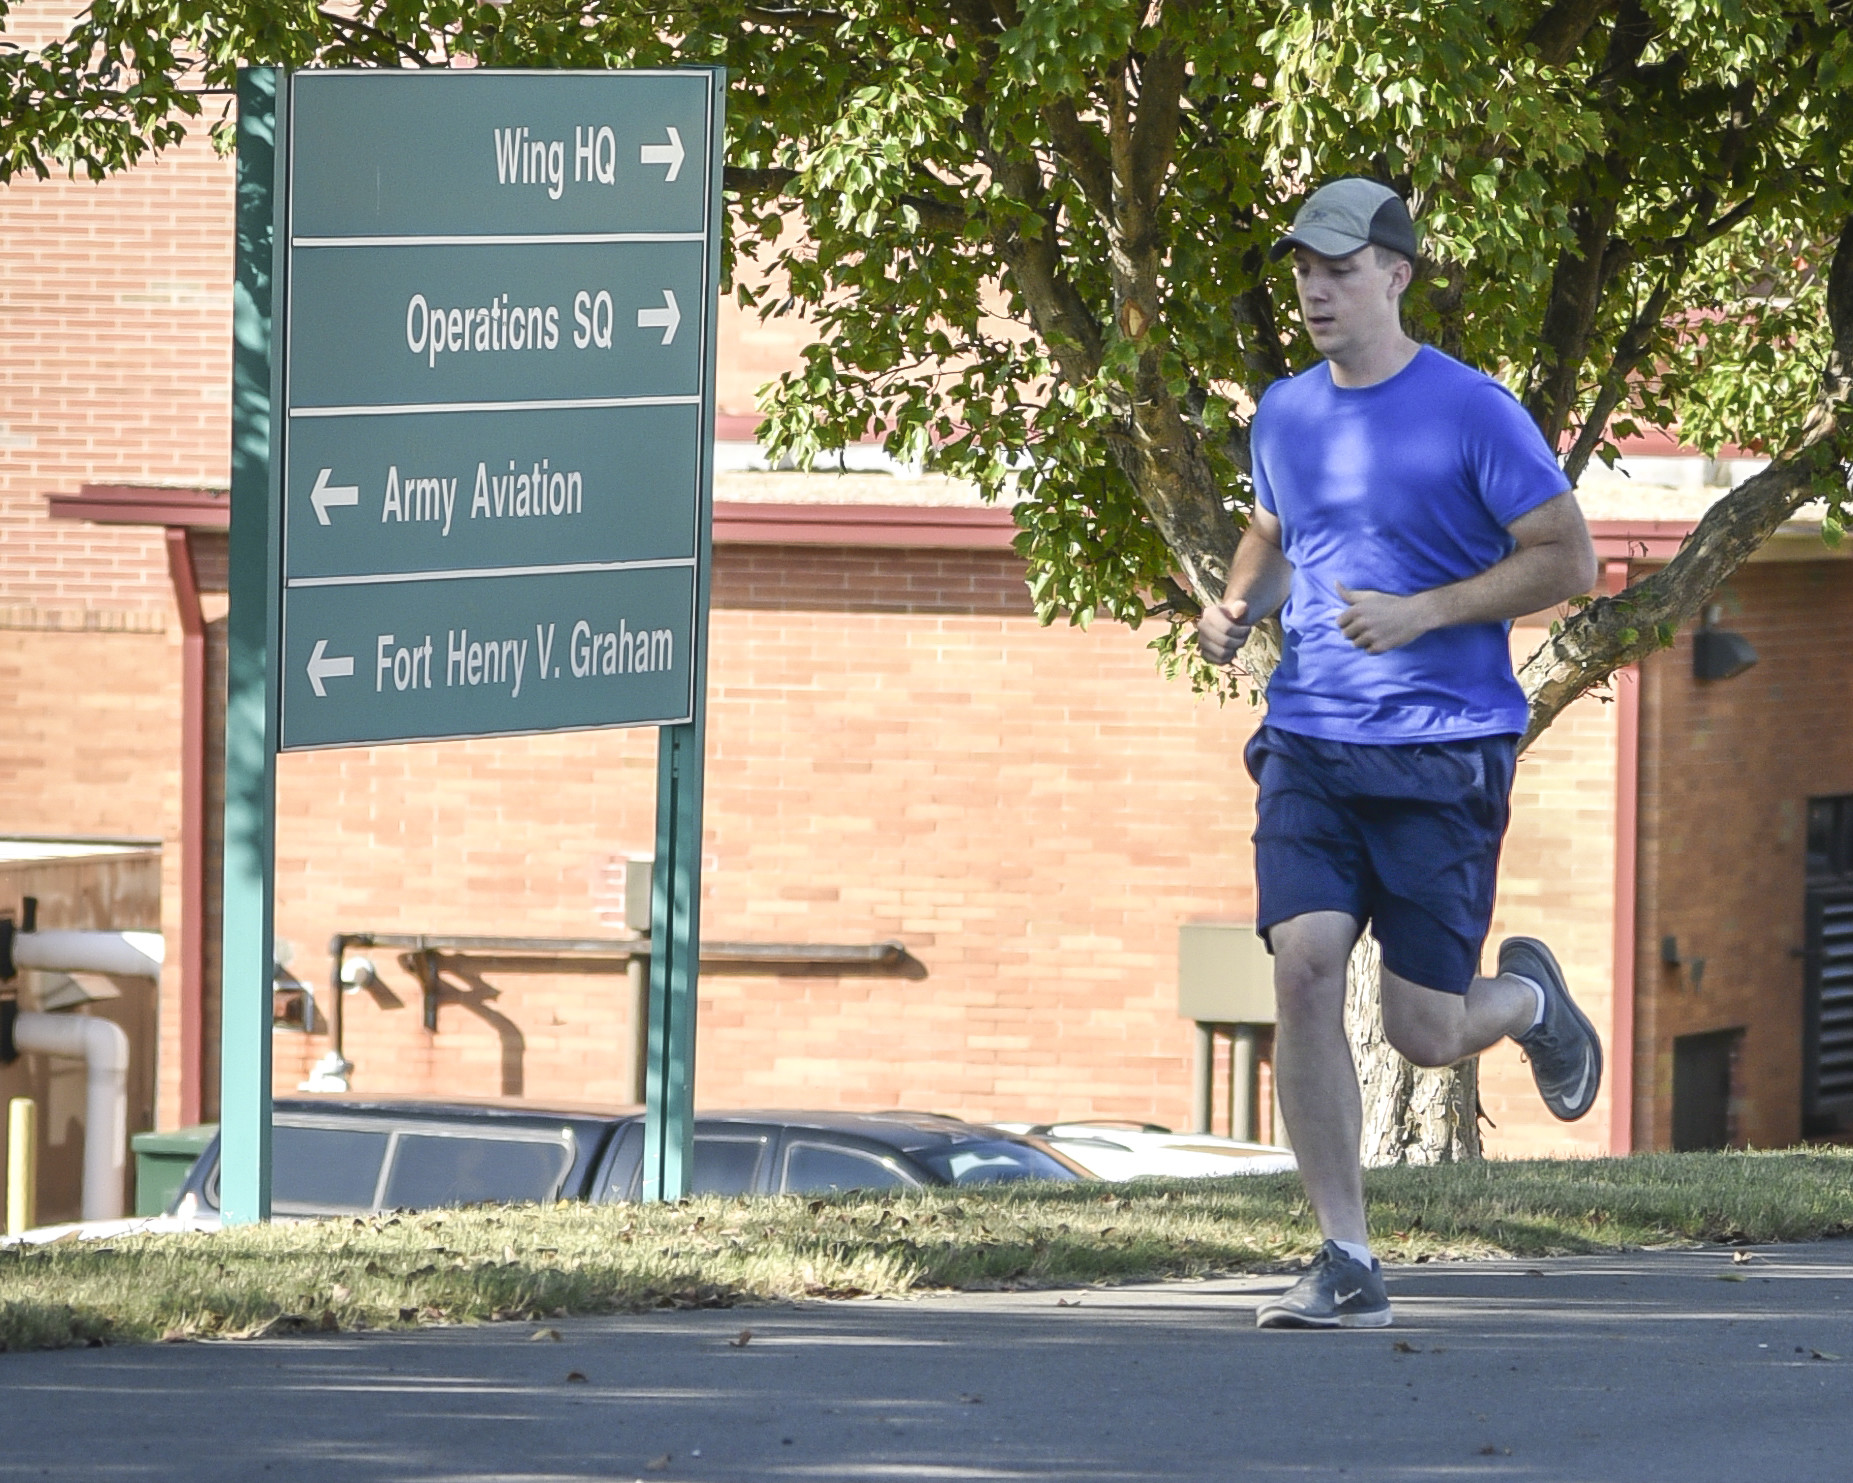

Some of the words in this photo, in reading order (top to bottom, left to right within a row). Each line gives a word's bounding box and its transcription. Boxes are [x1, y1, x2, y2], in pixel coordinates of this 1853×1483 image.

[494, 126, 565, 200] Wing
[574, 125, 616, 186] HQ
[406, 293, 560, 368] Operations
[573, 289, 614, 350] SQ
[381, 465, 458, 537] Army
[470, 458, 582, 519] Aviation
[376, 634, 433, 692] Fort
[447, 629, 528, 698] Henry
[536, 623, 560, 680] V.
[570, 618, 673, 678] Graham
